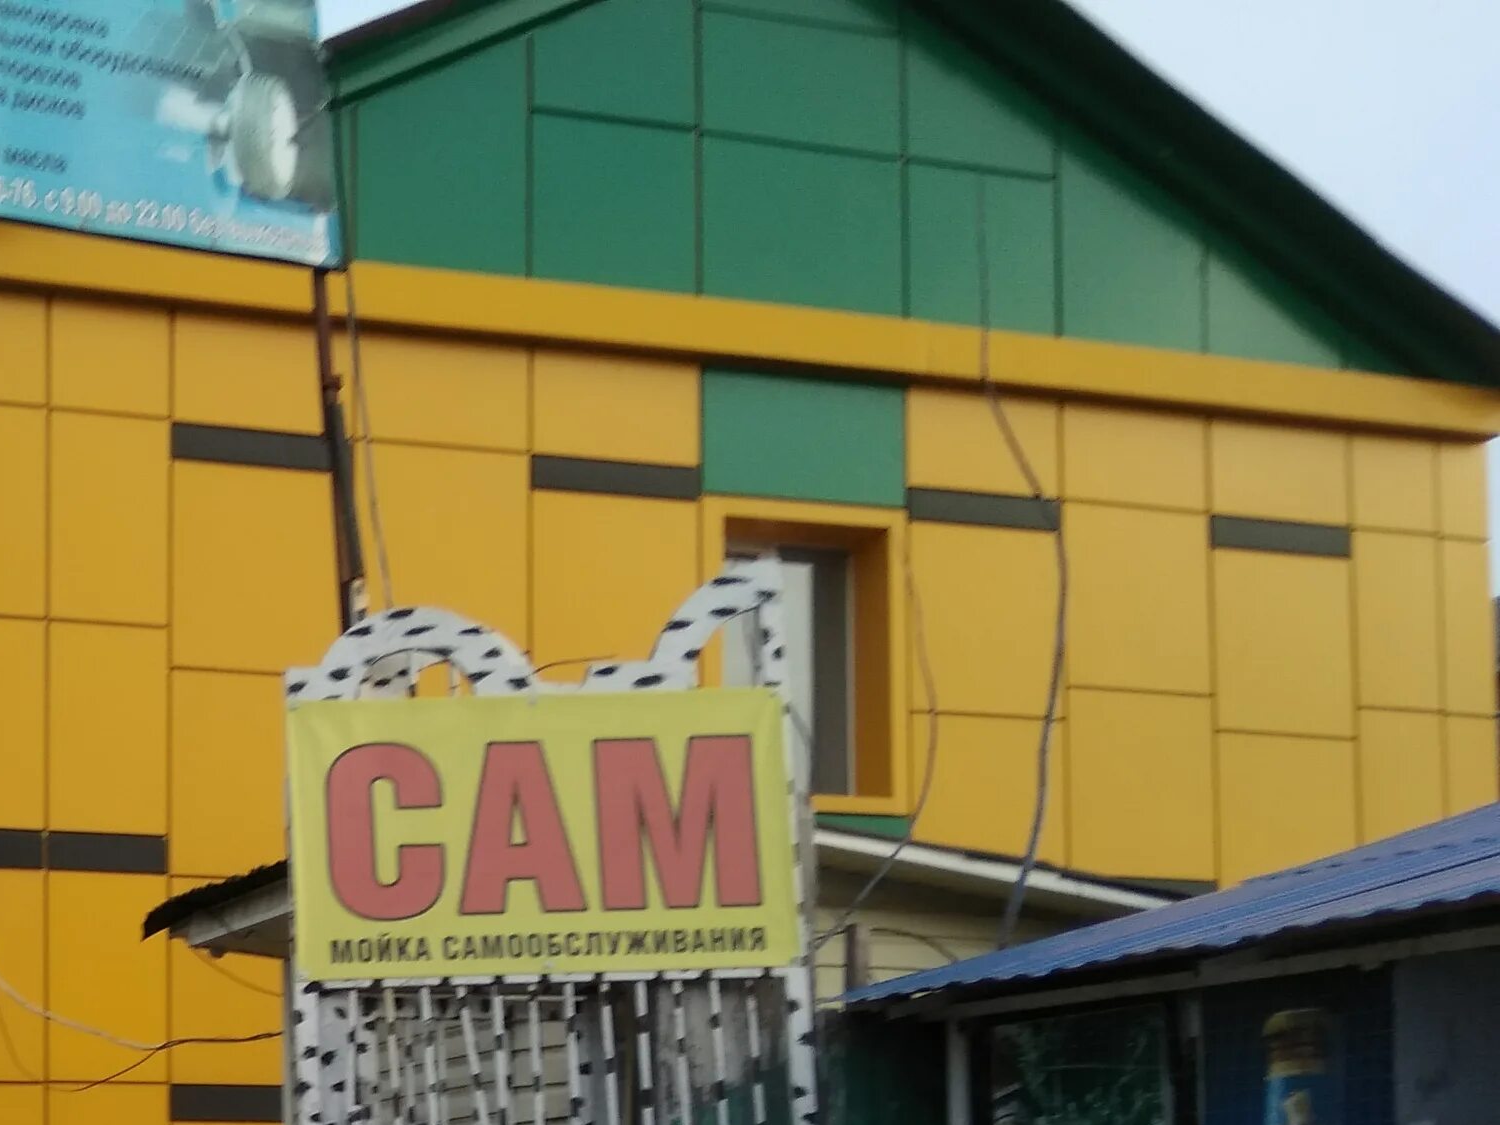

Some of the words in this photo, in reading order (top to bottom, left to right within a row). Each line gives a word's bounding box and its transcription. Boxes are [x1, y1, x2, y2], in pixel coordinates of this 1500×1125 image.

[325, 734, 764, 921] САМ
[329, 930, 432, 965] МОЙКА
[441, 926, 767, 961] САМООБСЛУЖИВАНИЯ
